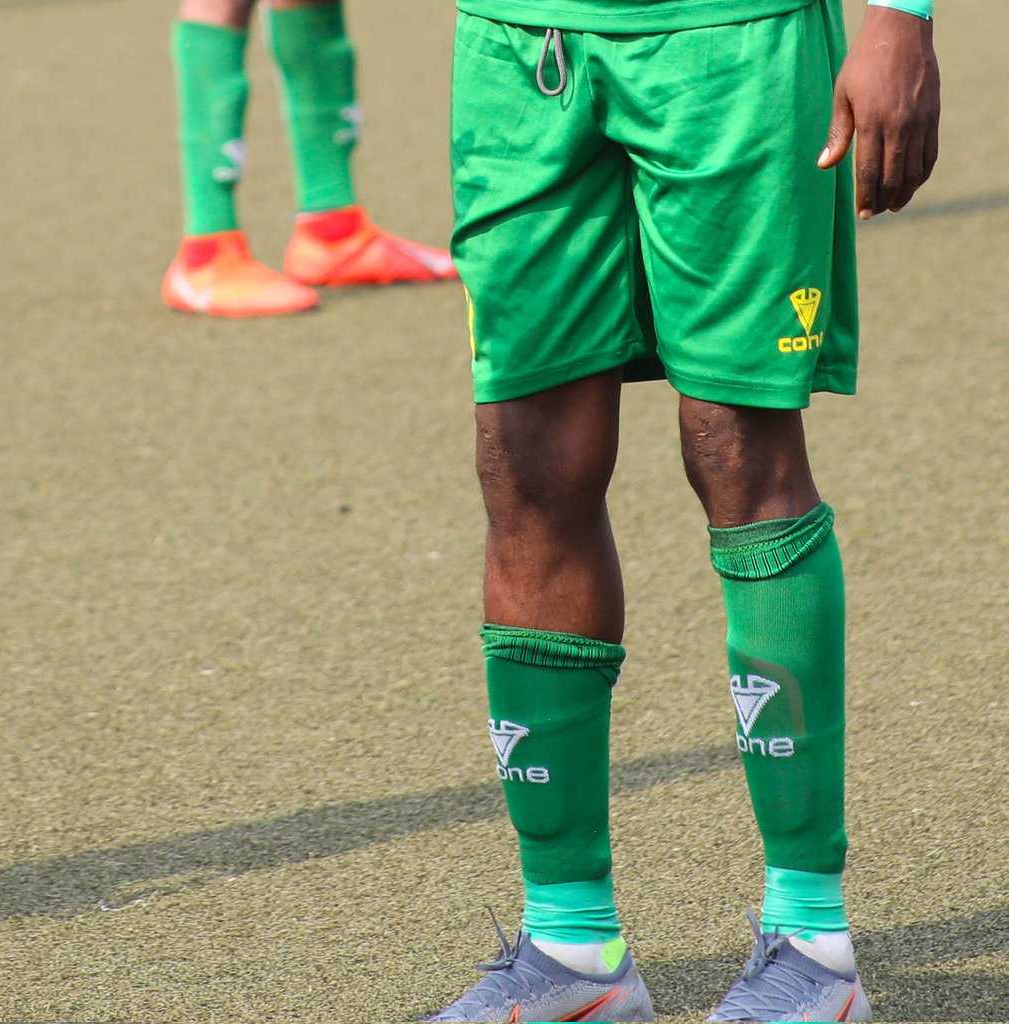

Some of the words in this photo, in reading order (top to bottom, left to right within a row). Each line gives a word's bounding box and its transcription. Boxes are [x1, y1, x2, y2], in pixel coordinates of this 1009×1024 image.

[778, 332, 823, 352] con
[735, 734, 794, 757] one
[496, 764, 550, 783] one
